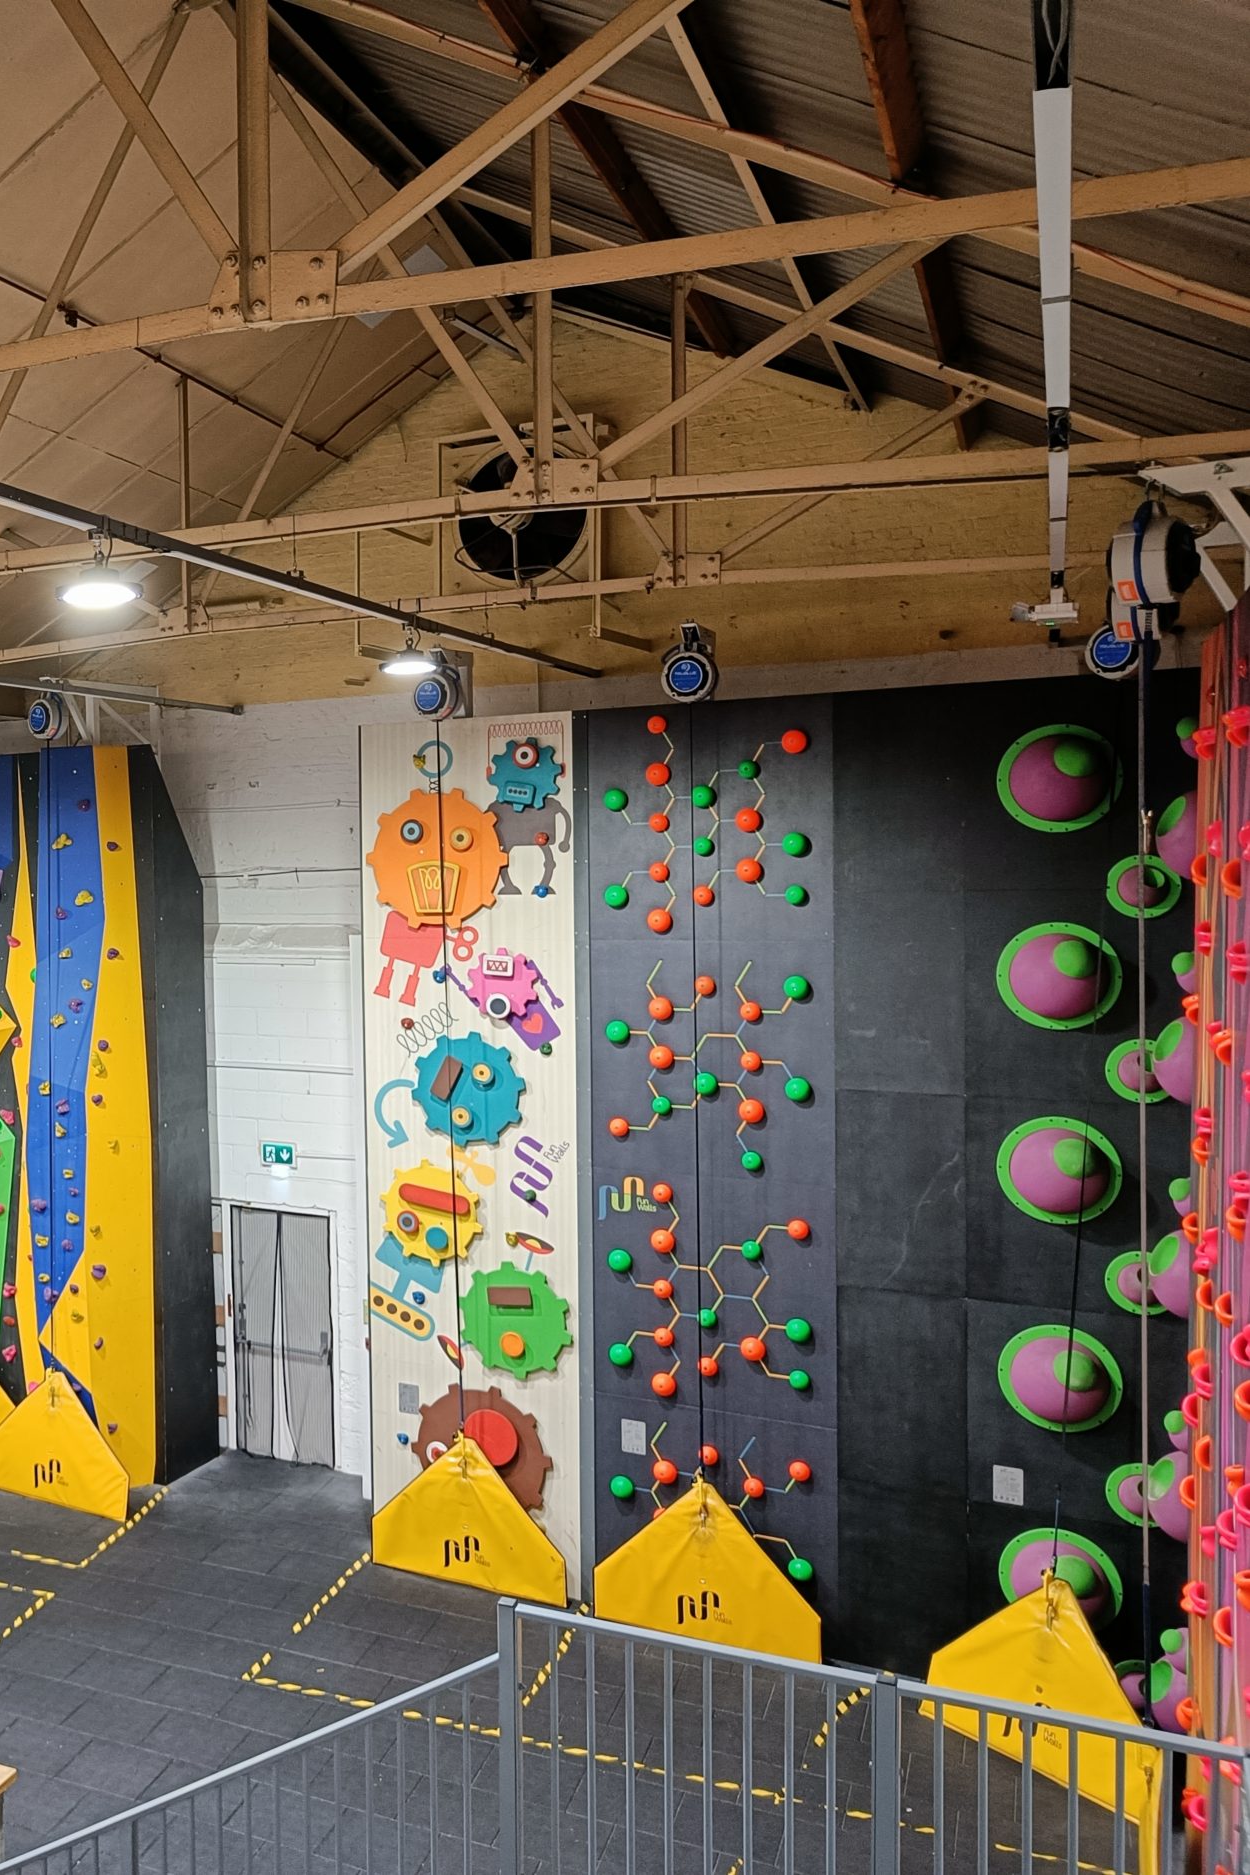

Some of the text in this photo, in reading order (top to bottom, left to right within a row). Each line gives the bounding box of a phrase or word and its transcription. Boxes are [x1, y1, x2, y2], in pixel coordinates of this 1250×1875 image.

[543, 1144, 557, 1161] Fun
[551, 1140, 570, 1163] Walls
[638, 1202, 657, 1212] Walls
